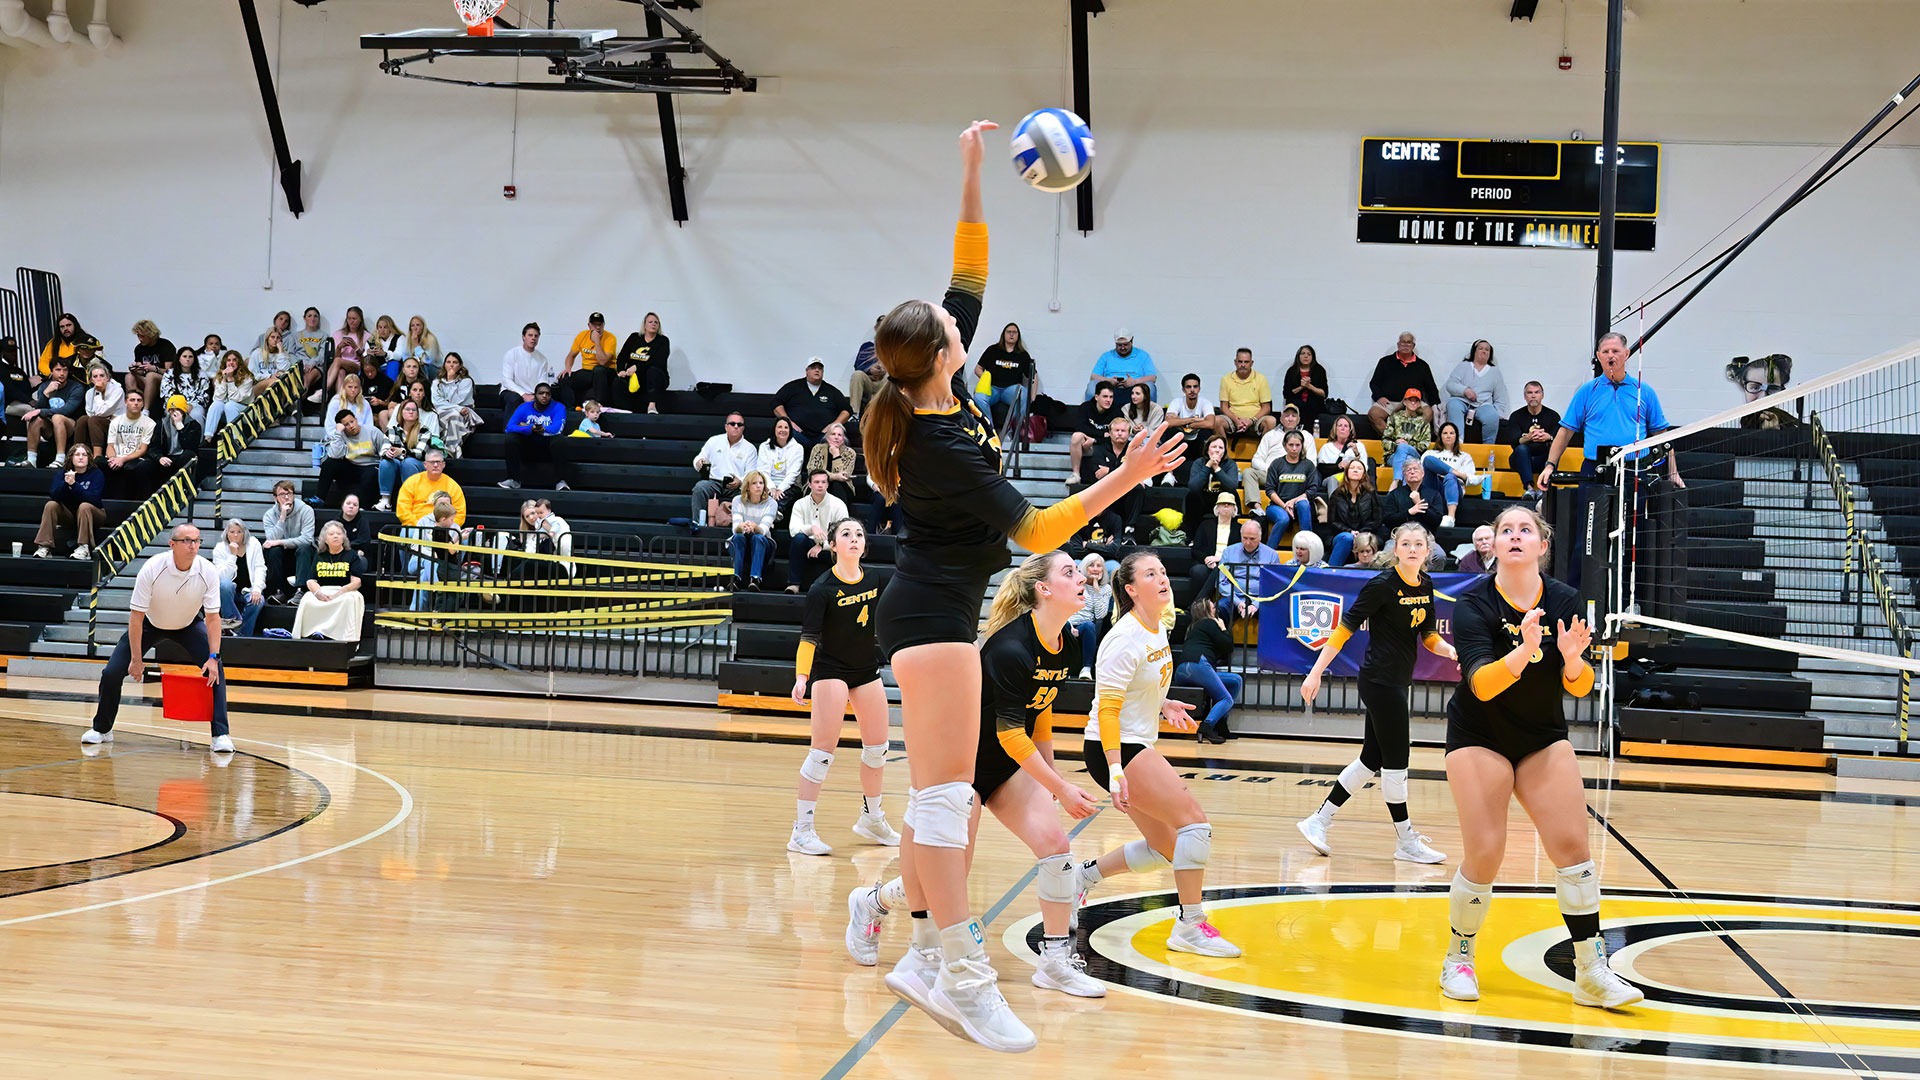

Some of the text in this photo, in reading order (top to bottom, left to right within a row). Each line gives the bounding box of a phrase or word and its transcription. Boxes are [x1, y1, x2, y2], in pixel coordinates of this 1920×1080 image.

[1382, 142, 1441, 161] CENTRE
[1471, 187, 1512, 200] PERIOD
[1399, 219, 1445, 240] HOME
[1455, 221, 1475, 241] OF
[1485, 222, 1515, 242] THE
[316, 561, 350, 571] CENTRE
[856, 604, 869, 627] 4
[1301, 605, 1332, 628] 50
[1410, 607, 1427, 628] 19
